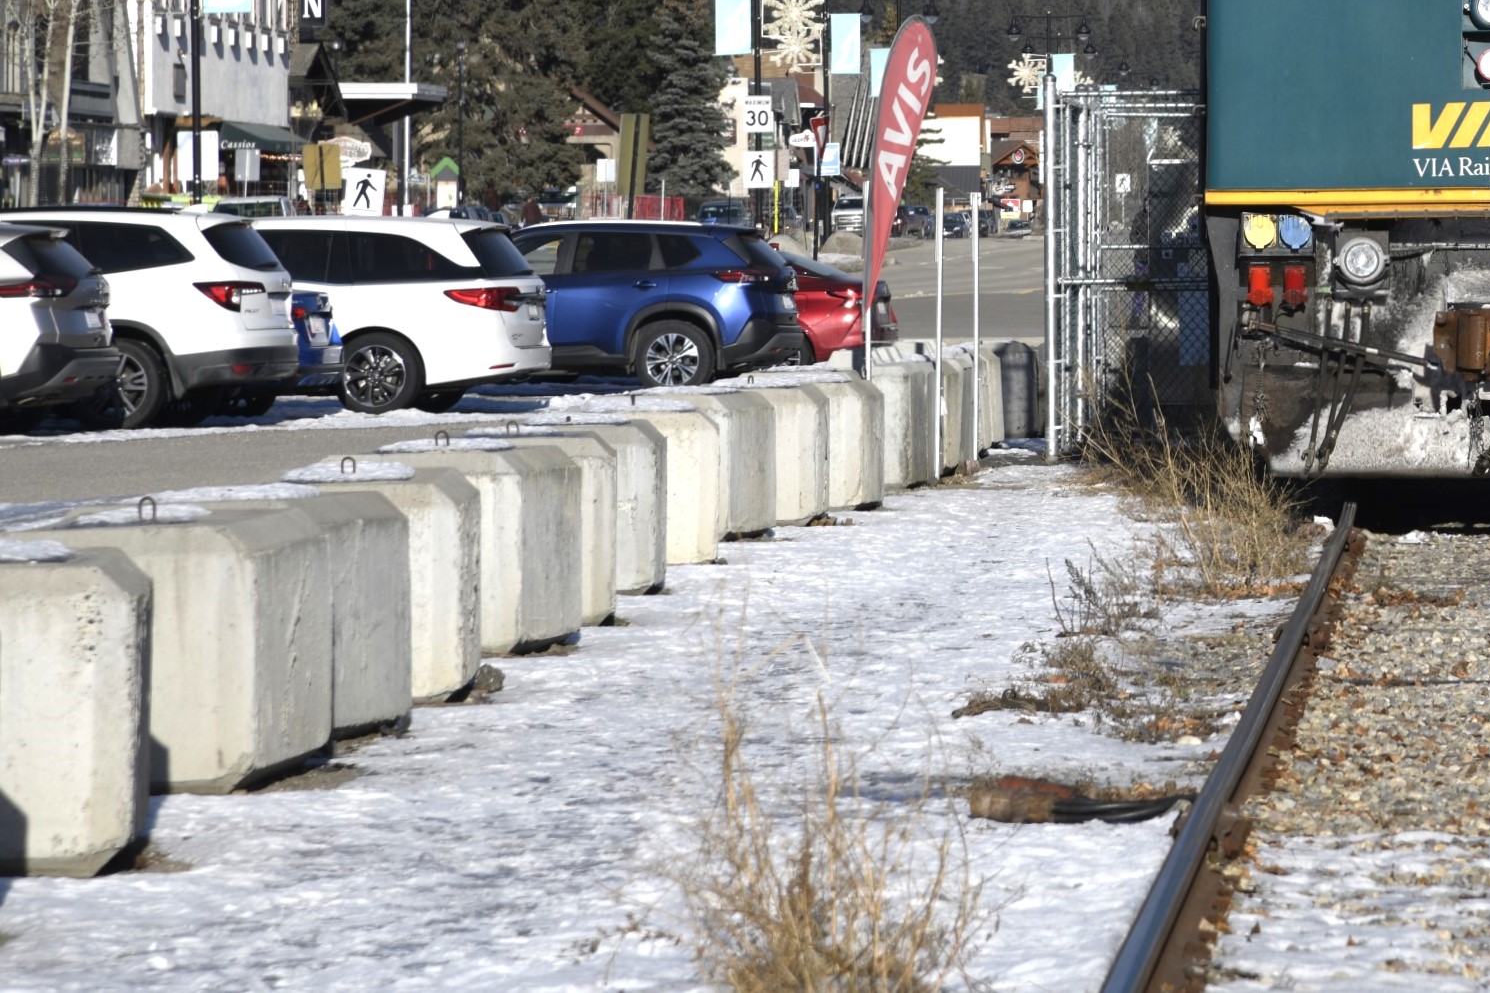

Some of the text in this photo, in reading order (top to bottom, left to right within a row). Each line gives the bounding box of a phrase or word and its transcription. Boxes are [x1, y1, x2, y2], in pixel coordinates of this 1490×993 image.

[745, 110, 769, 127] 30
[878, 46, 931, 202] AVIS
[220, 139, 256, 150] Cassios
[1413, 158, 1455, 178] VIA
